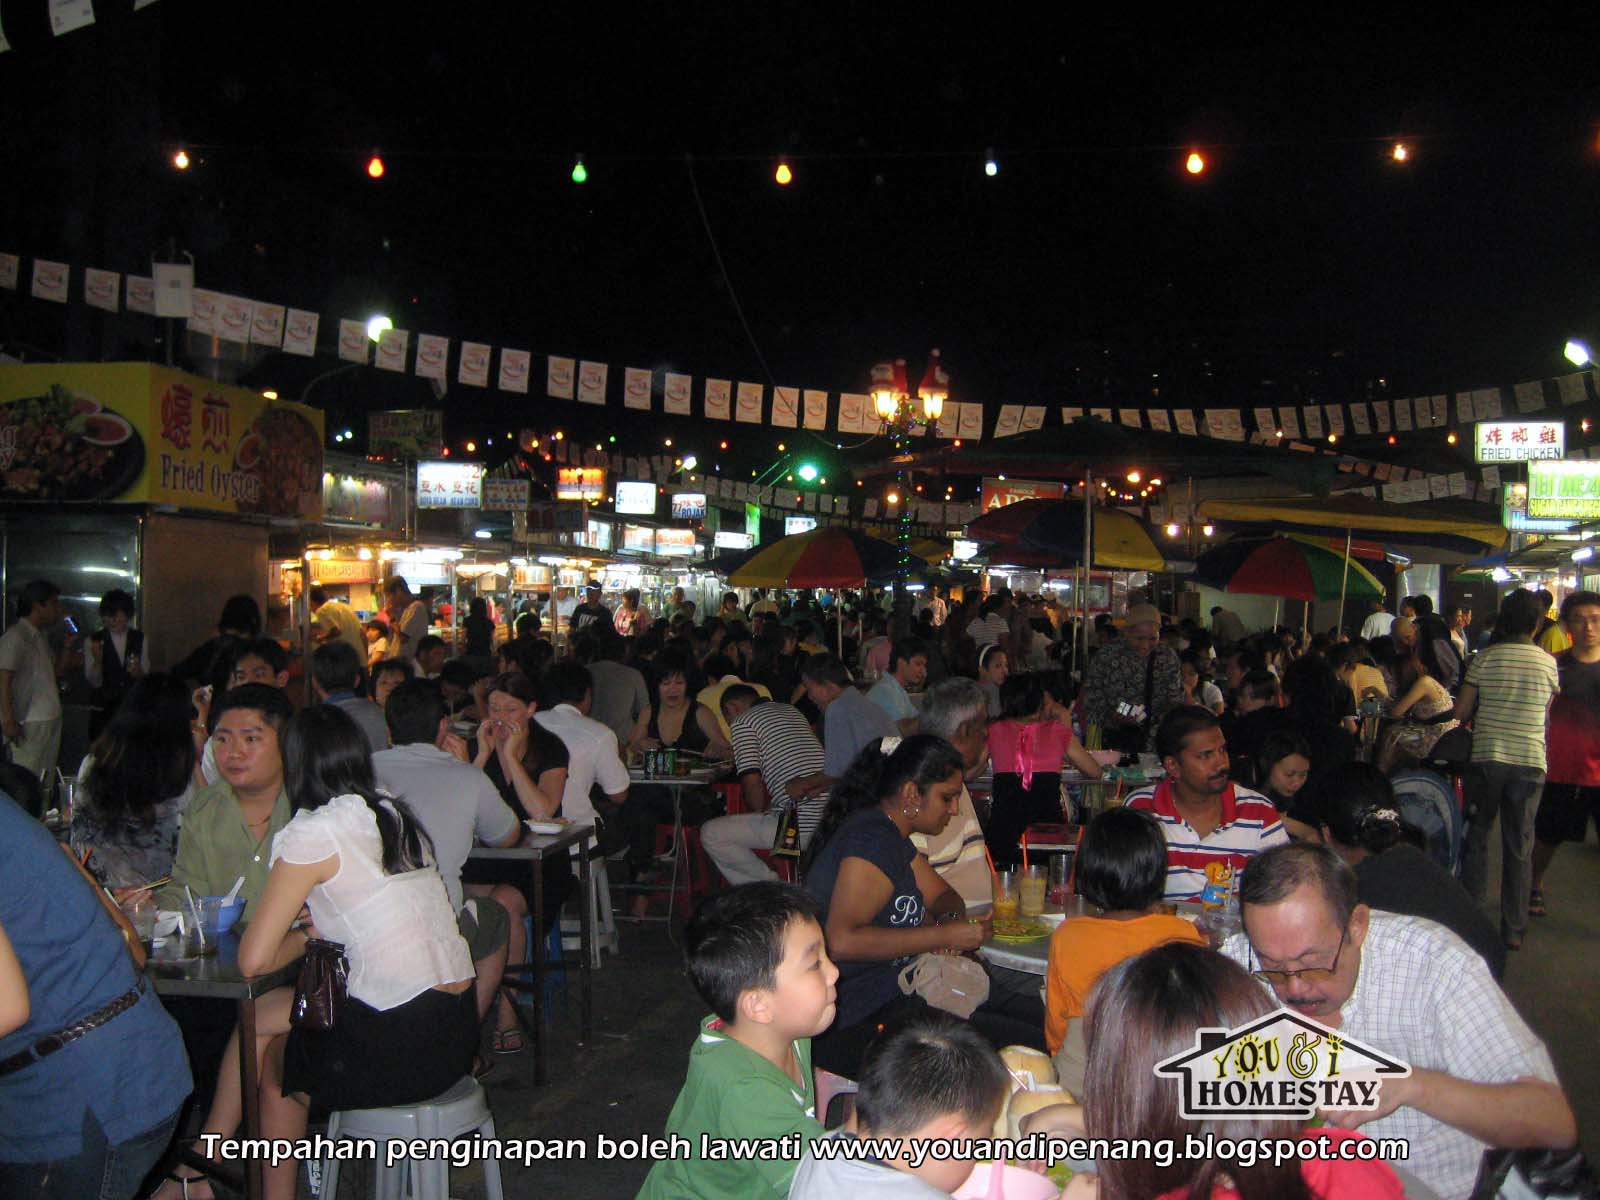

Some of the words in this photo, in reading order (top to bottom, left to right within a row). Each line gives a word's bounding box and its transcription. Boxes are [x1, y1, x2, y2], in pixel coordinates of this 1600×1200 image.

[1481, 447, 1511, 460] FRIED
[1516, 447, 1561, 460] CHICKEN
[160, 453, 205, 493] Fried
[210, 463, 261, 502] Oyster
